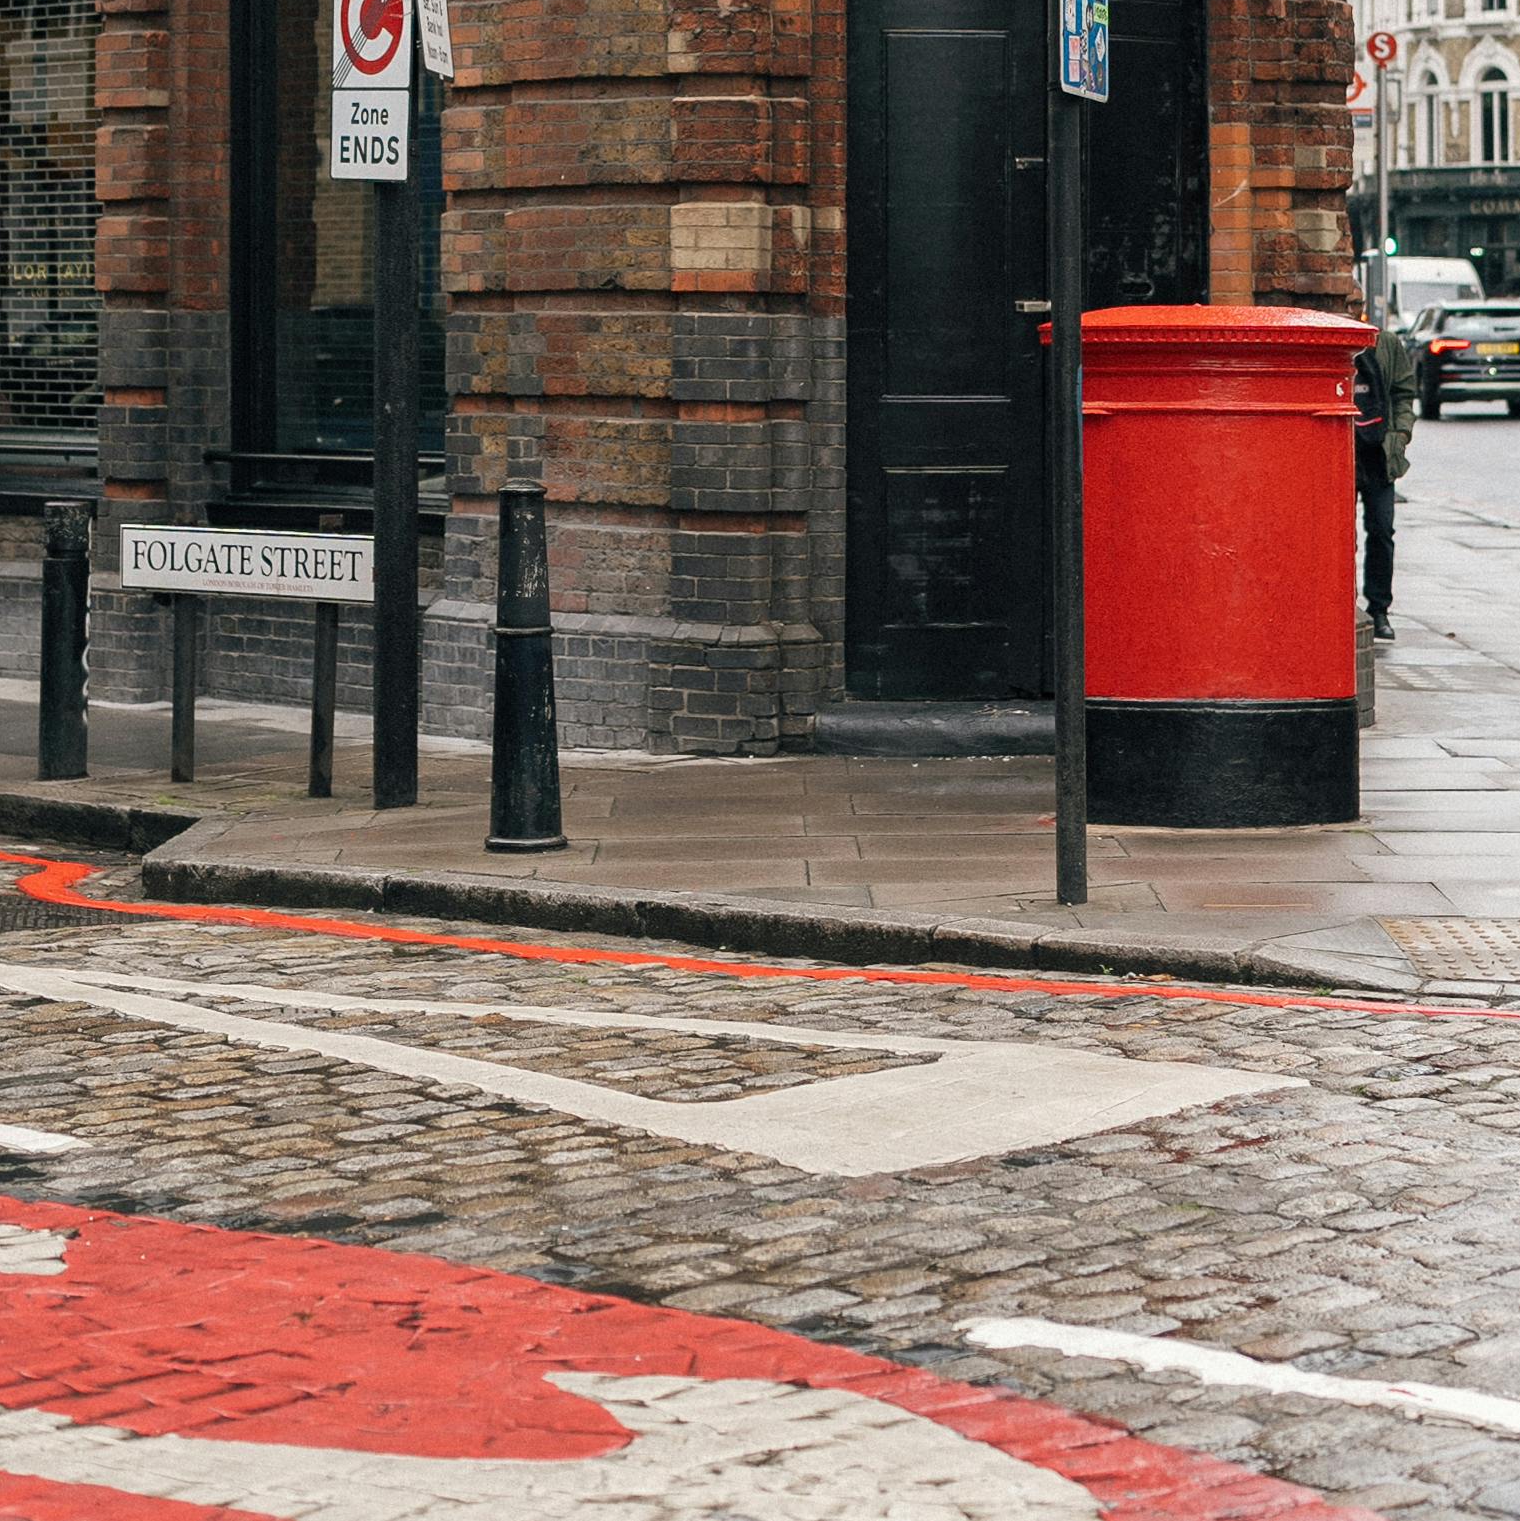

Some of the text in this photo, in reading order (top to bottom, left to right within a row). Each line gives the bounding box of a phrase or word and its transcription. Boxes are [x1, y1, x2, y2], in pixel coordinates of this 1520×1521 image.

[350, 102, 389, 125] Zone
[339, 135, 400, 166] ENDS
[132, 539, 363, 582] FOLGATE STREET
